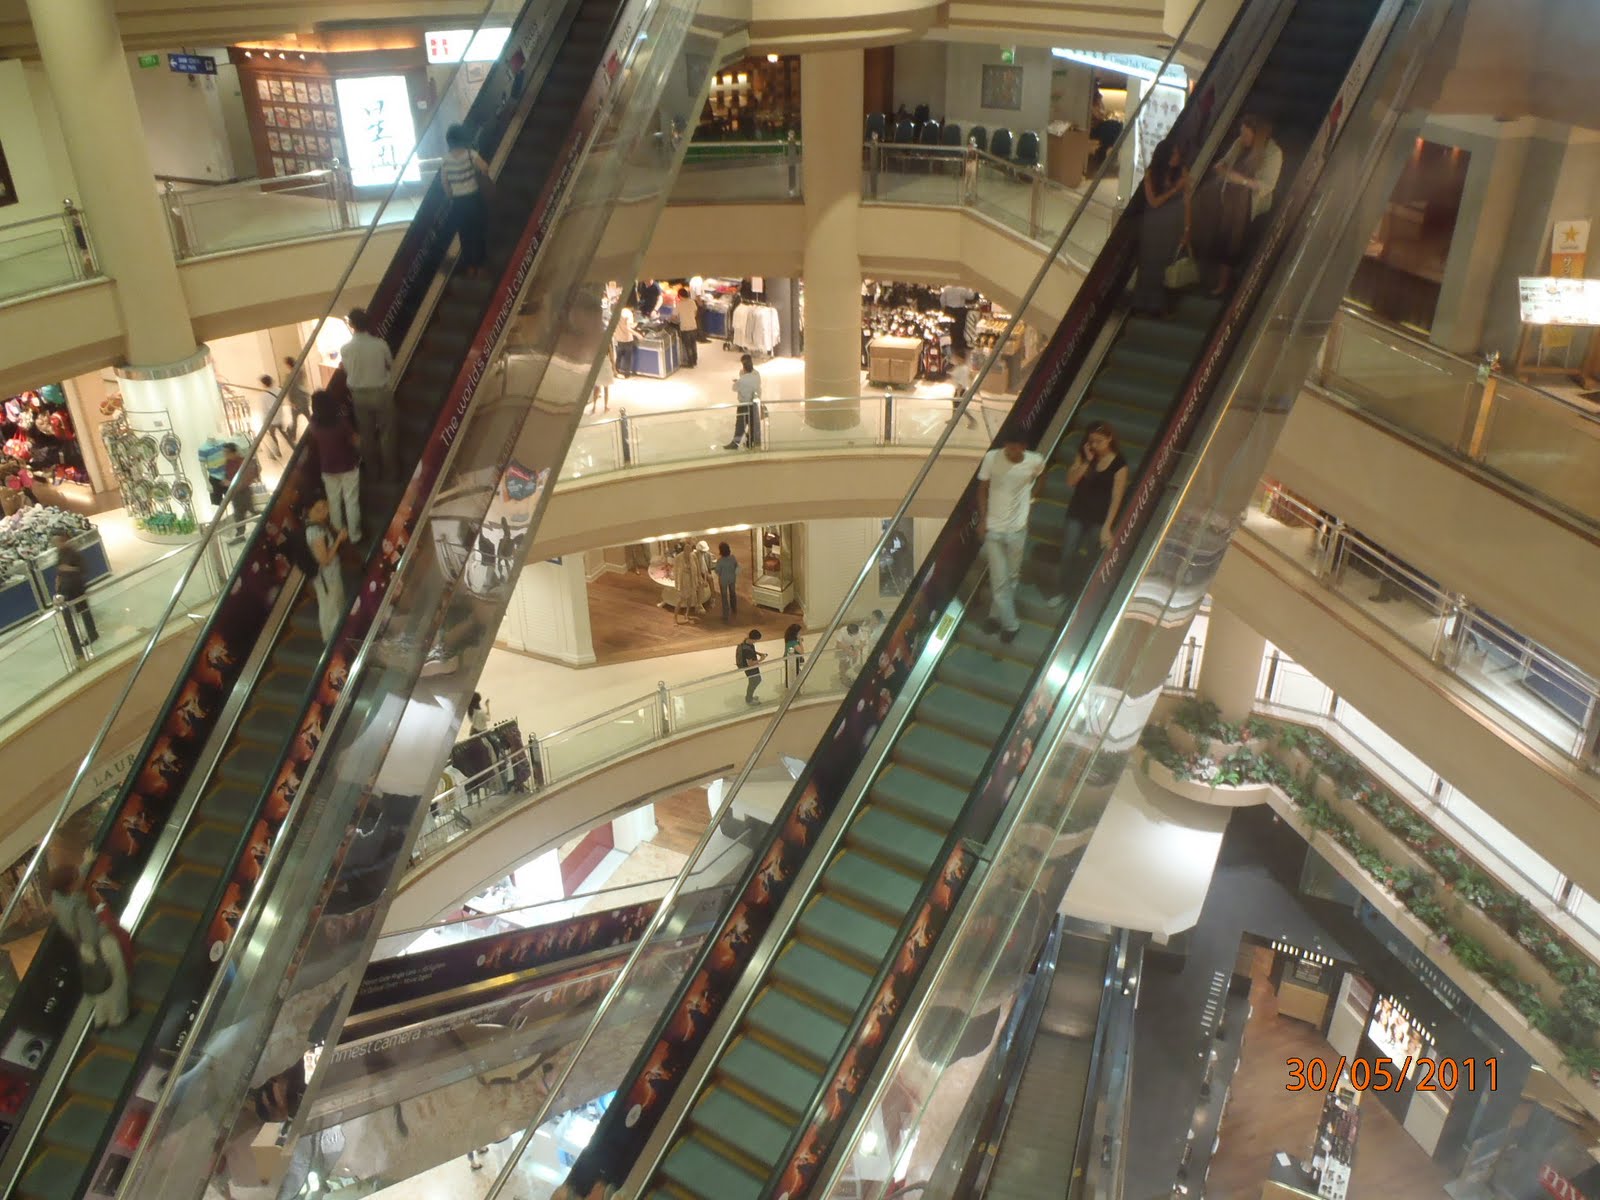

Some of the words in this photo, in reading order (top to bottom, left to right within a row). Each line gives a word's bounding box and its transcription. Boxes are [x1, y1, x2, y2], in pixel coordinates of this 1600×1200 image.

[376, 277, 411, 339] limmest
[440, 416, 459, 447] The
[457, 358, 485, 415] world's
[483, 286, 516, 357] slimmest
[512, 235, 539, 293] camera
[1021, 357, 1063, 432] limmest
[1099, 550, 1119, 584] The
[1119, 478, 1156, 545] world's
[1155, 385, 1198, 475] slimmest
[1197, 324, 1231, 393] camera
[373, 1027, 423, 1051] camera
